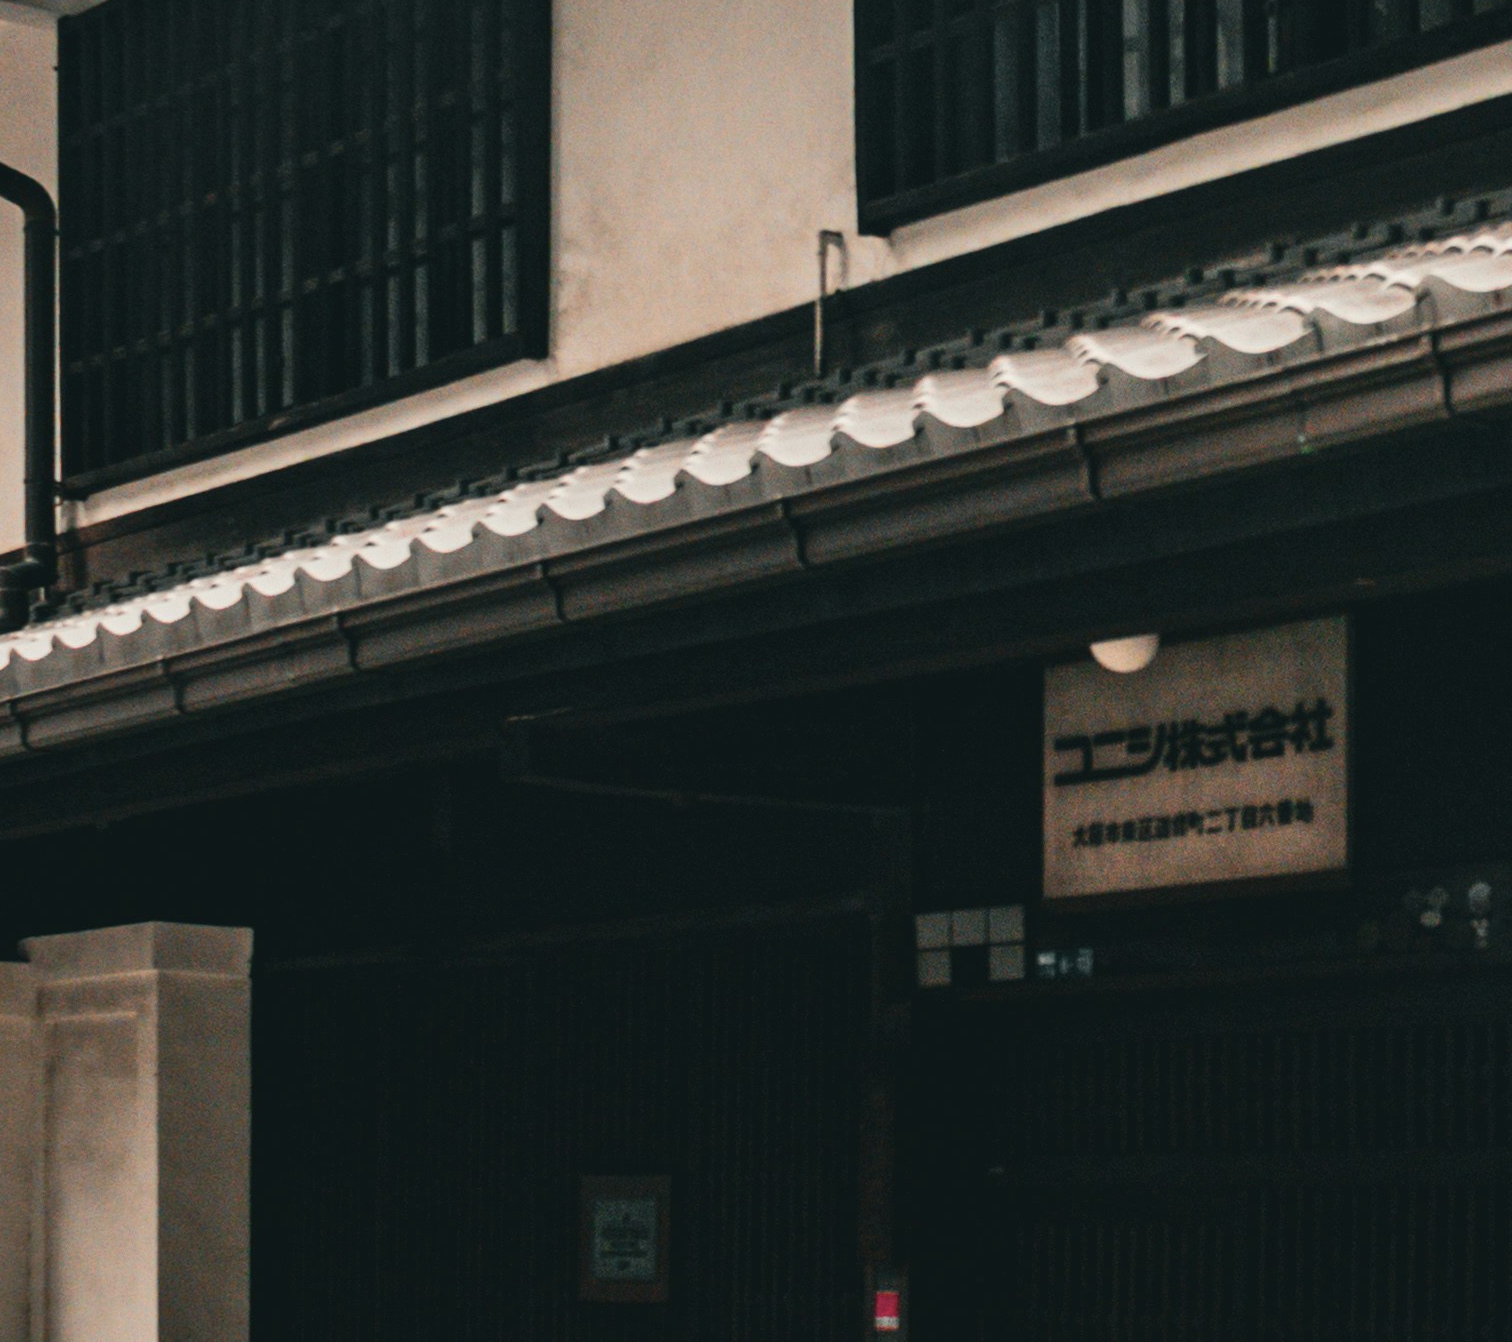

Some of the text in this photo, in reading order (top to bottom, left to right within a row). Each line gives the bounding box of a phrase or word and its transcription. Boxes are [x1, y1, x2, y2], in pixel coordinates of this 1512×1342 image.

[1054, 698, 1335, 787] コニシ株式会社
